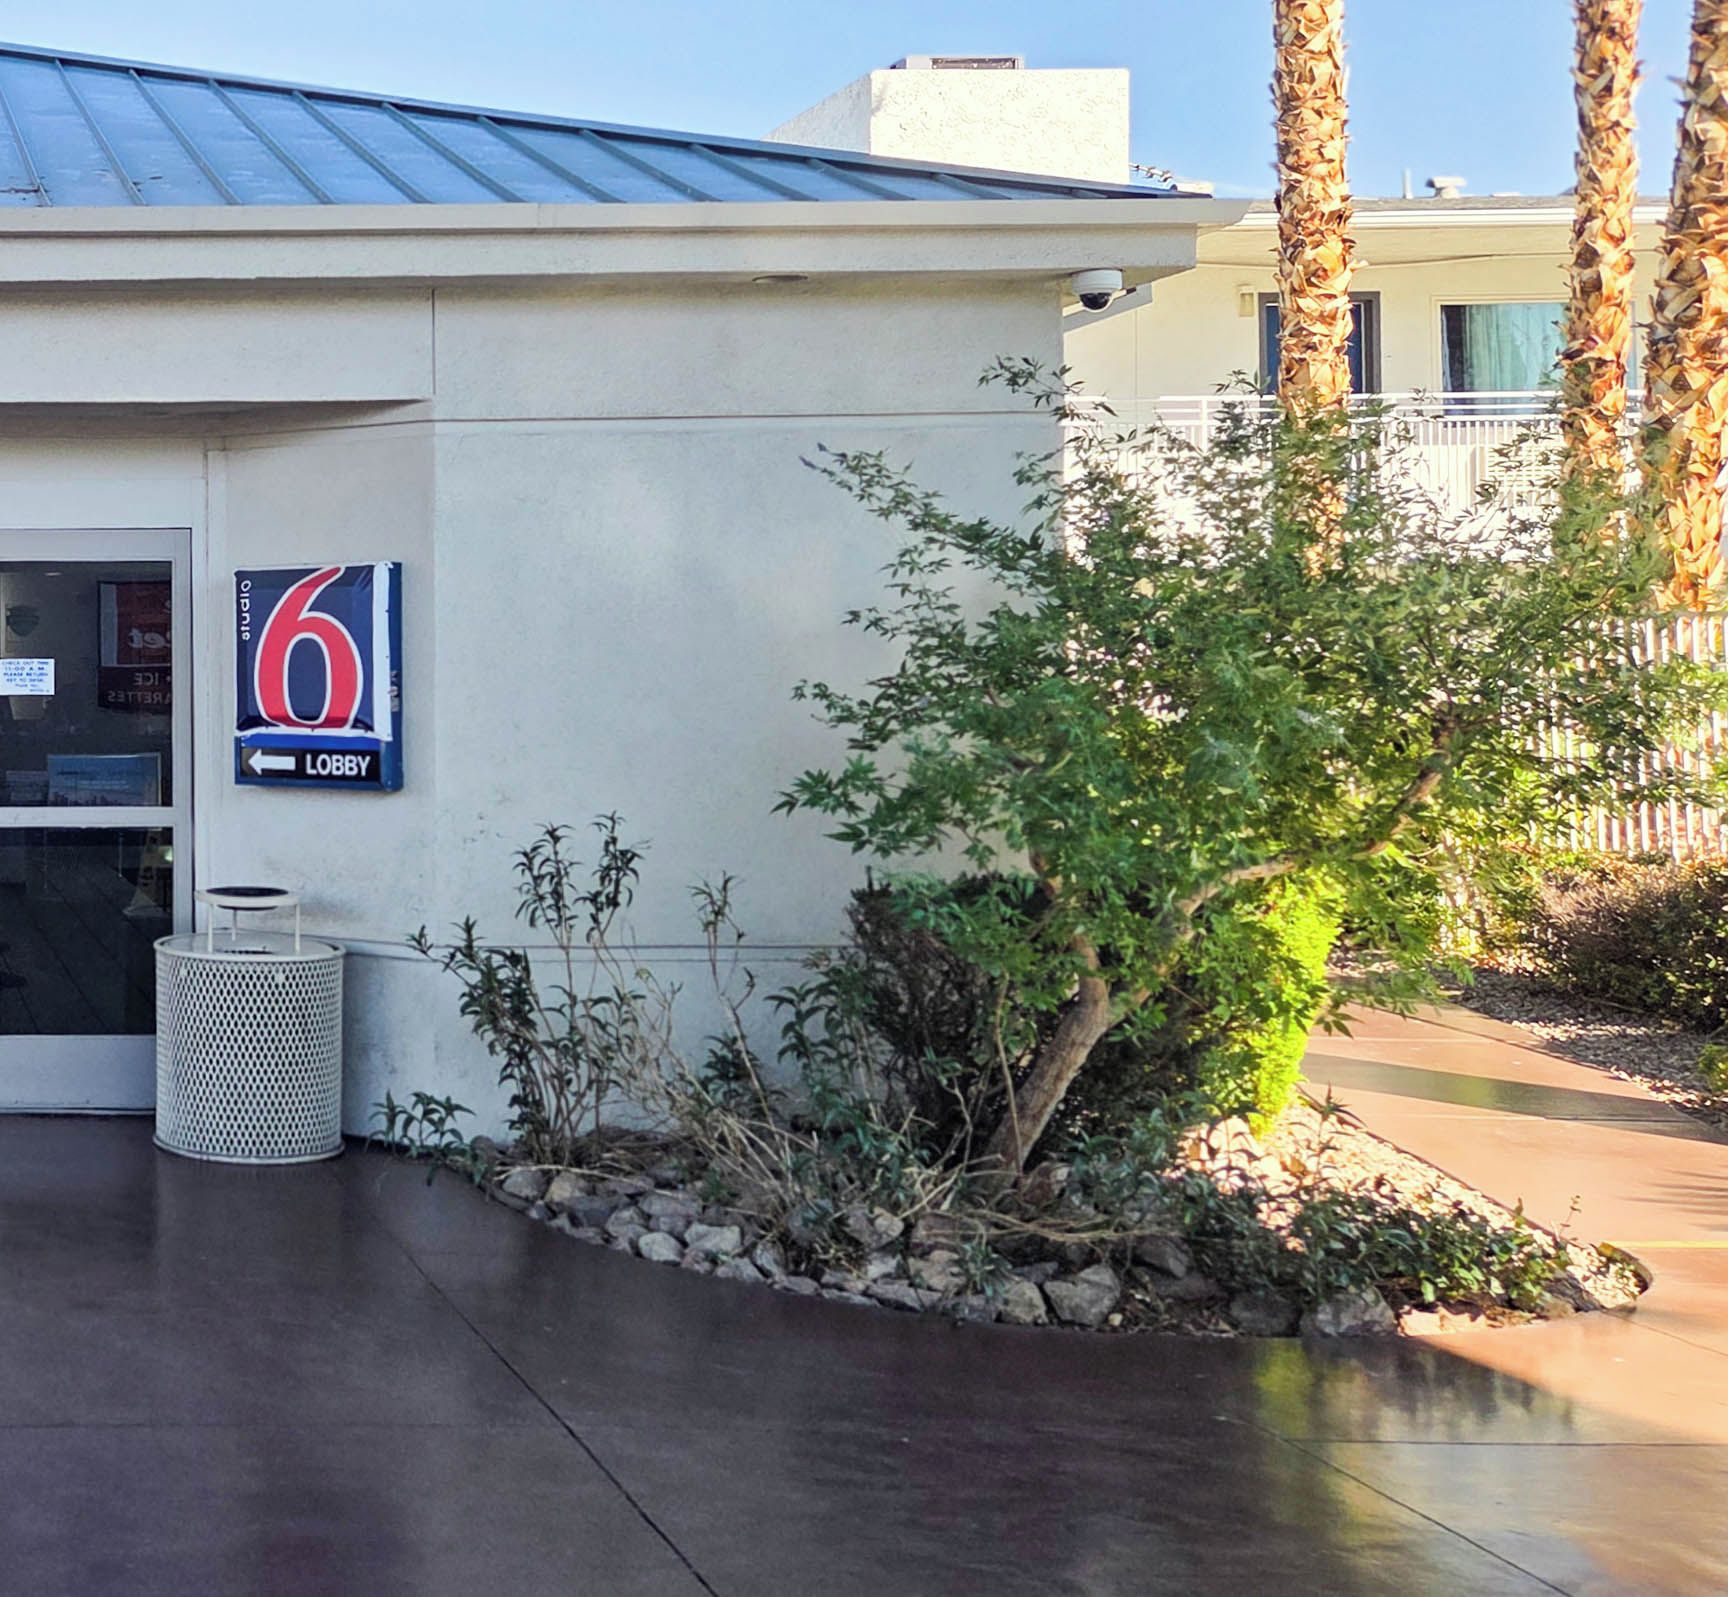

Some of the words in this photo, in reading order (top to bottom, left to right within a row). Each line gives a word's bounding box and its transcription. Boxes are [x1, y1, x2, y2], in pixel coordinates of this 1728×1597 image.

[240, 580, 252, 641] studio
[253, 565, 364, 730] 6
[305, 753, 371, 777] LOBBY
